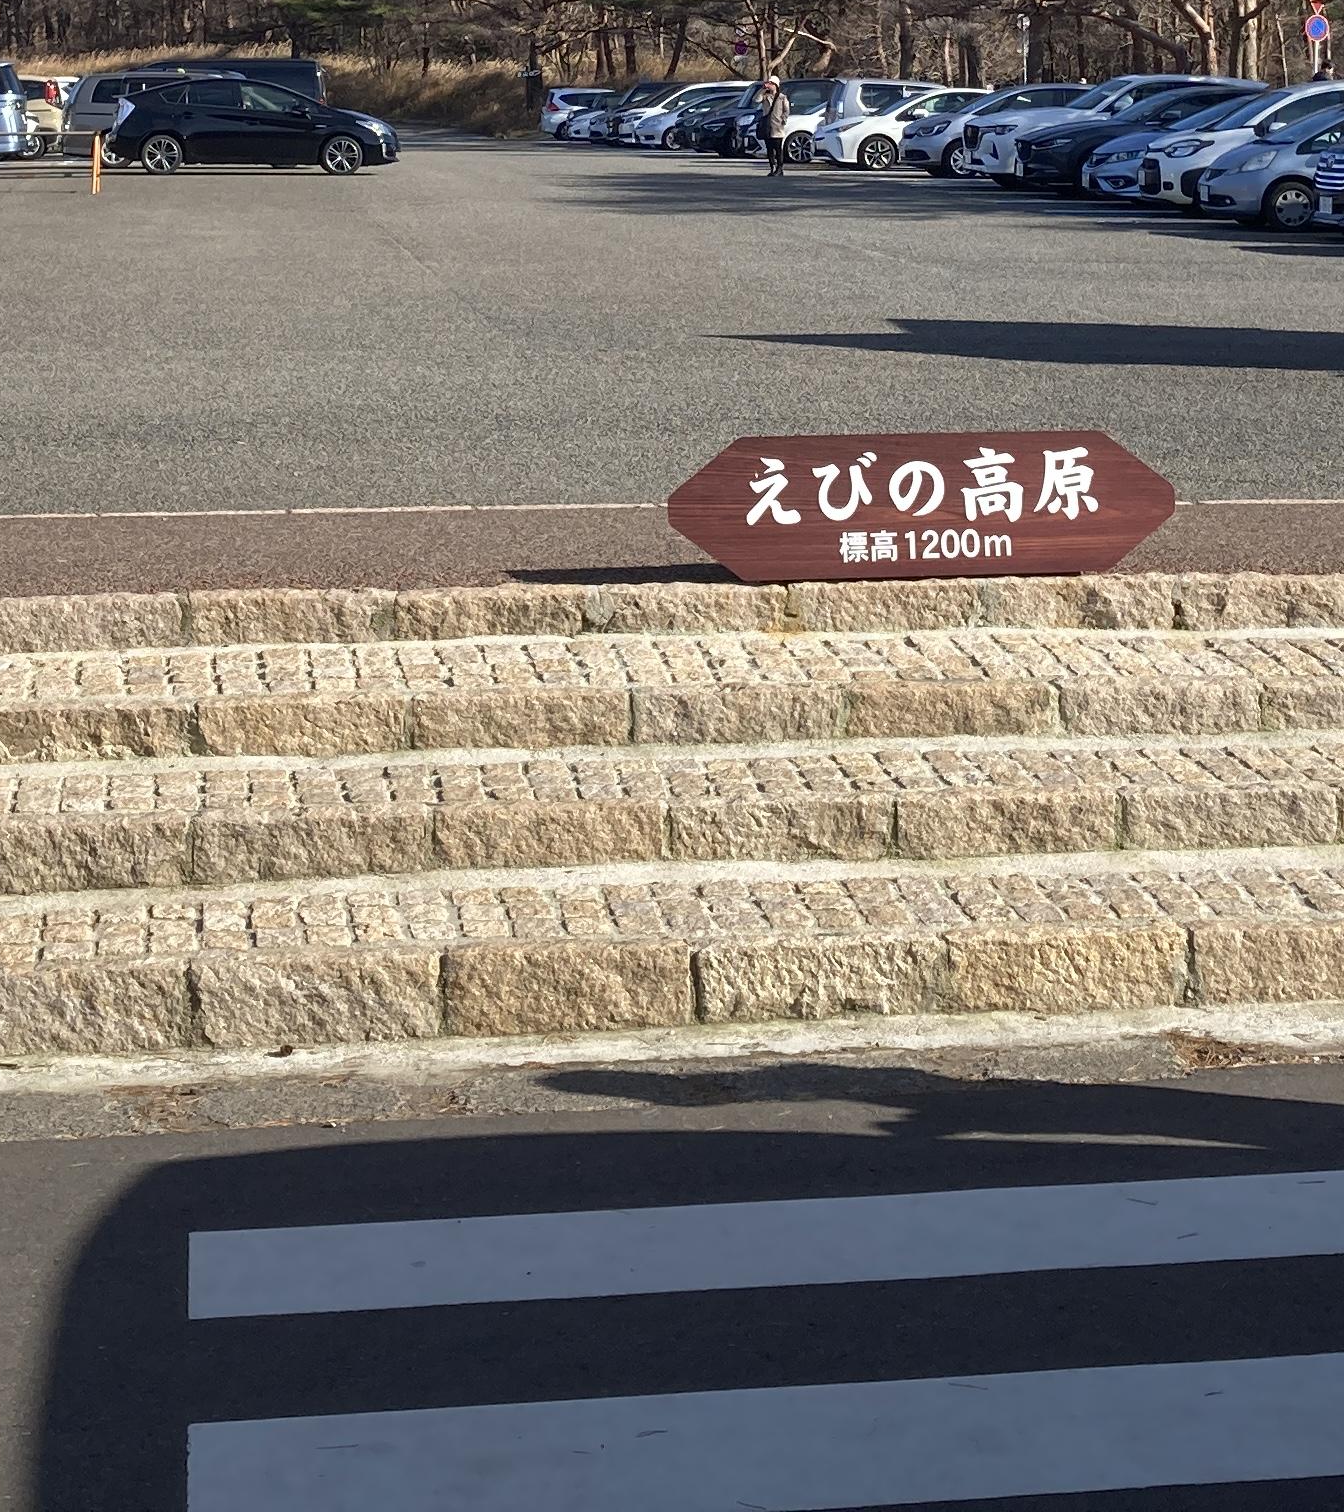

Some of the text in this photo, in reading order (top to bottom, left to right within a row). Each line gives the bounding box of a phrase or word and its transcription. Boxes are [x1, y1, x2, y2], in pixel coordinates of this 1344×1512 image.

[746, 446, 1100, 526] えびの高原
[839, 529, 1013, 563] 標高1200m
